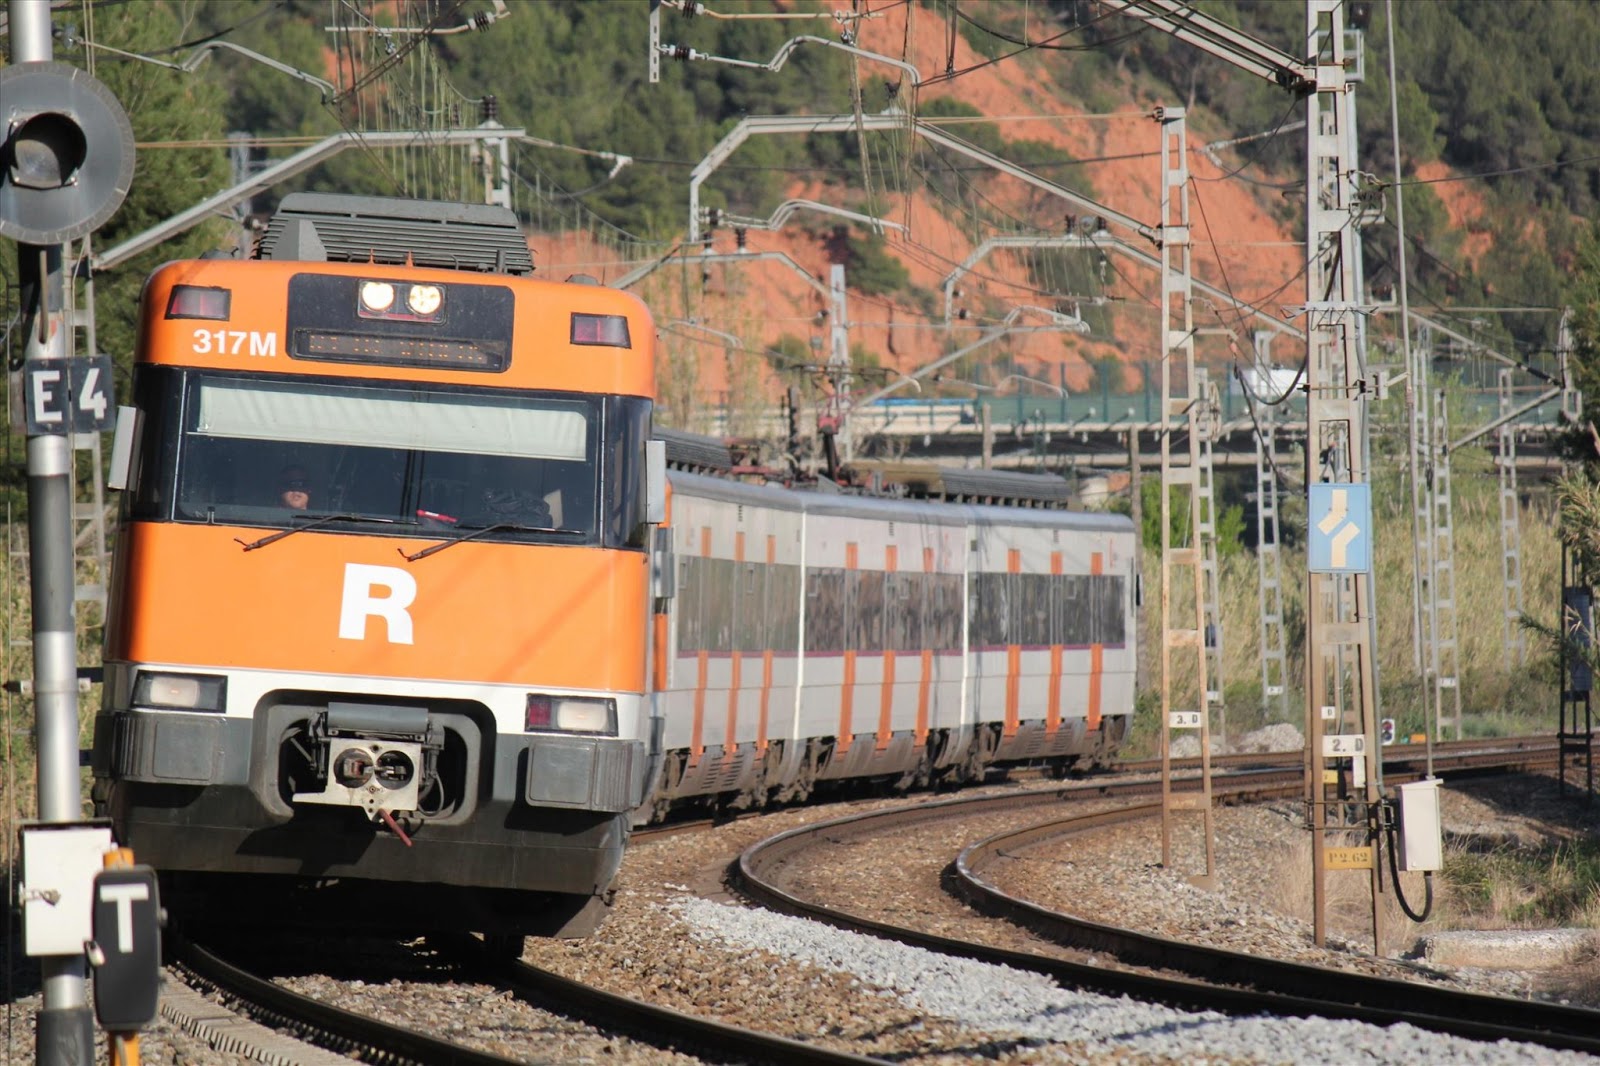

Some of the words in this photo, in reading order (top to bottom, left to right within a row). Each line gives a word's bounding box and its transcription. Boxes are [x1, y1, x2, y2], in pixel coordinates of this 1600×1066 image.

[192, 328, 277, 357] 317M
[32, 370, 63, 423] E
[79, 367, 107, 419] 4
[338, 562, 417, 645] R
[100, 883, 149, 953] T
